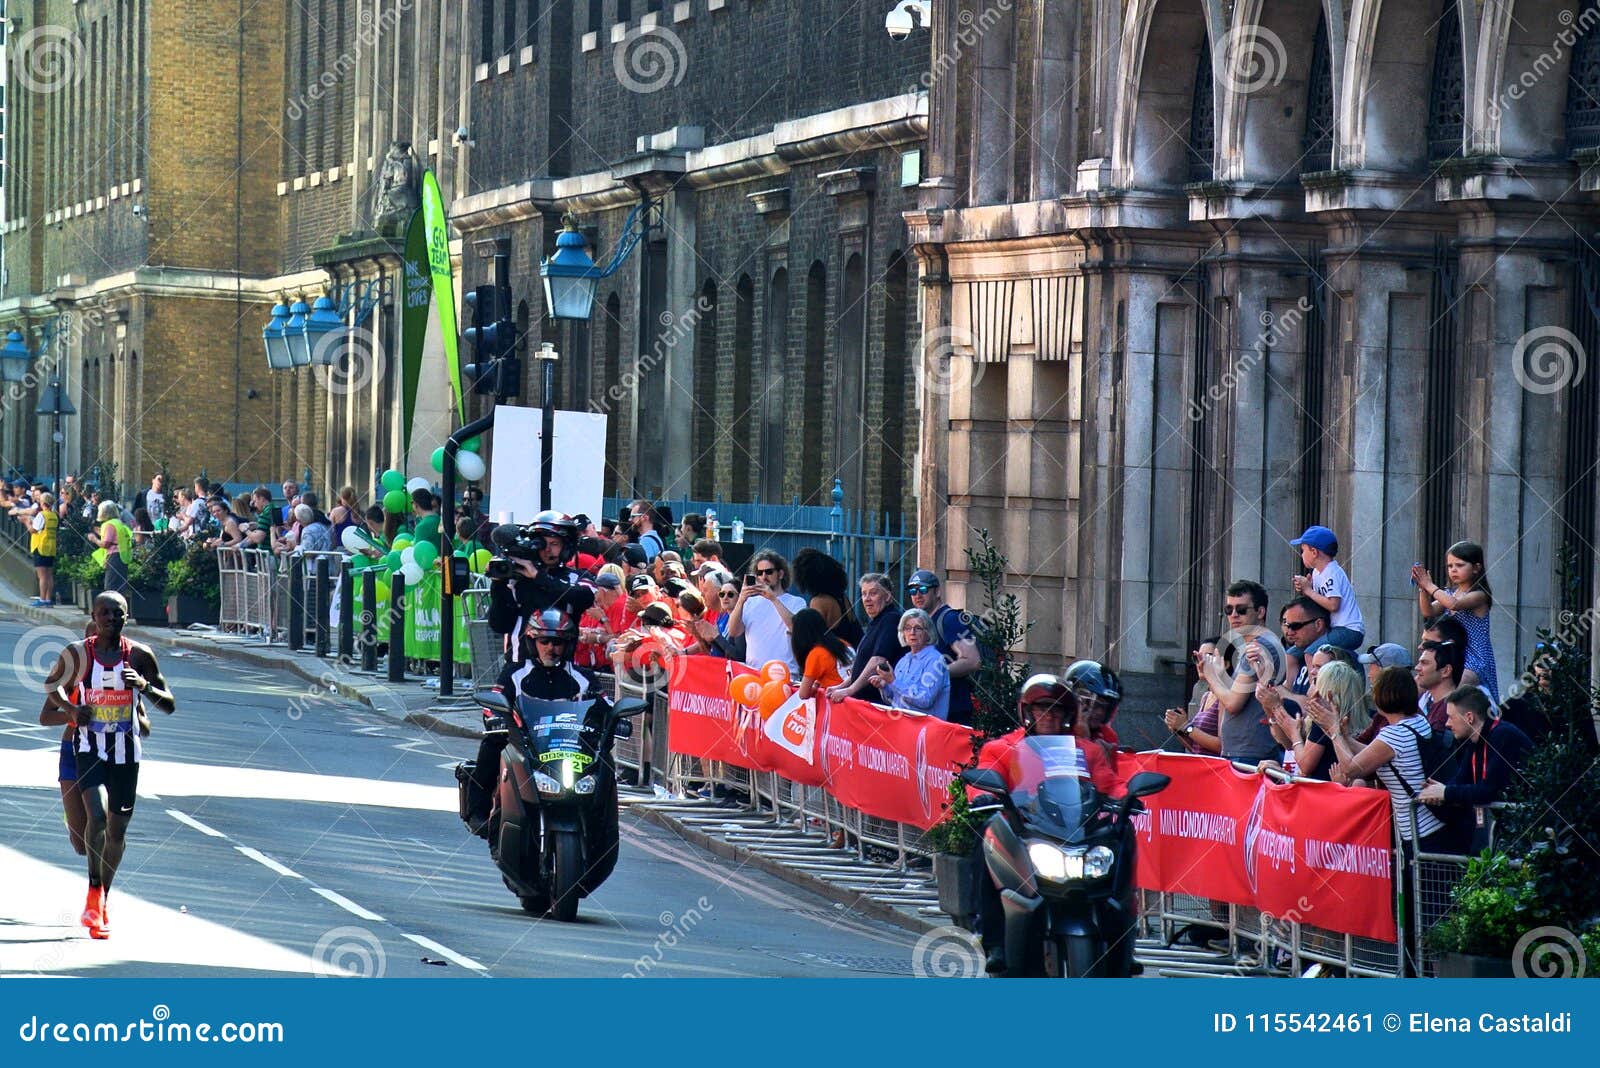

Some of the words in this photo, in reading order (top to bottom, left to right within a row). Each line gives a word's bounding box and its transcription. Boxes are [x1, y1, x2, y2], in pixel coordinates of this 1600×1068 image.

[95, 707, 119, 721] ACE
[706, 696, 731, 721] MARATHO
[572, 761, 581, 770] 2
[1159, 809, 1178, 836] MINI
[1178, 811, 1209, 839] LONDON
[1208, 814, 1237, 845] MARATHON
[1305, 839, 1321, 868] MINI
[1320, 840, 1359, 873] LONDON
